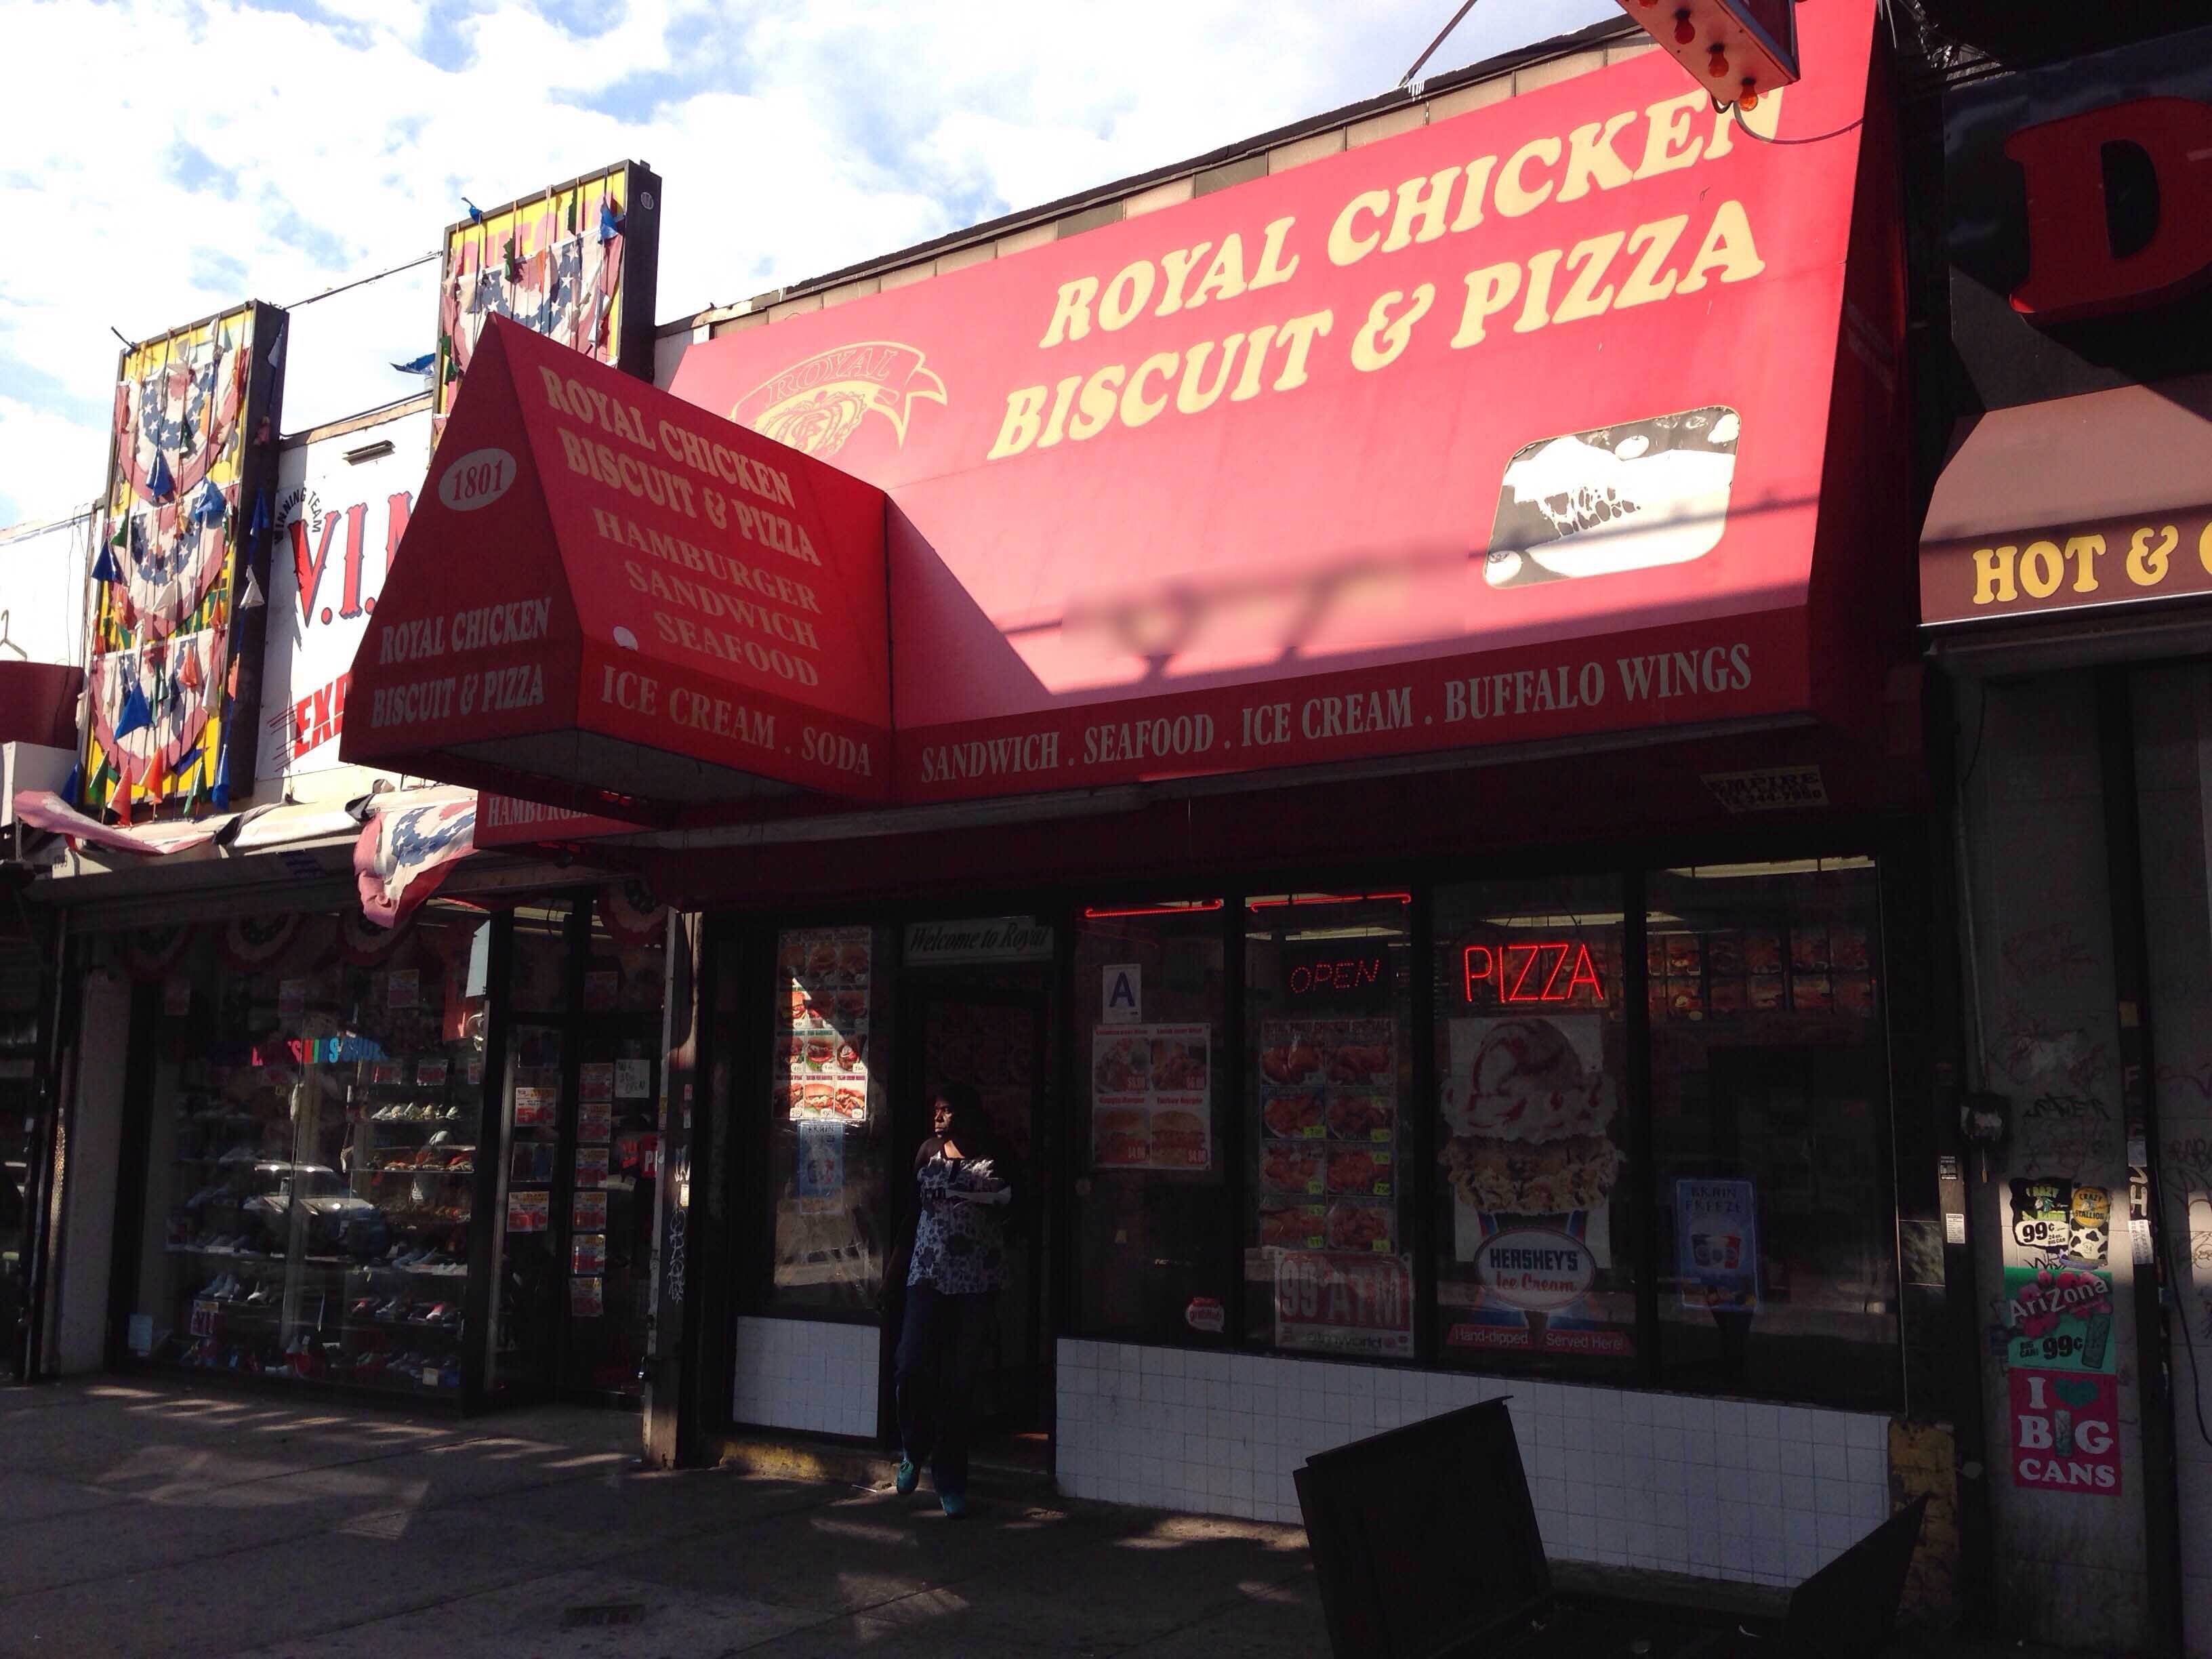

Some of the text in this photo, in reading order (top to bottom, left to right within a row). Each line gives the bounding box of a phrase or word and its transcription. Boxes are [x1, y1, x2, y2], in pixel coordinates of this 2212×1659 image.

[1039, 83, 1786, 348] ROYAL CHICKEN
[987, 199, 1766, 460] BISCUIT & PIZZA
[765, 348, 897, 407] ROYAL
[539, 365, 796, 510] ROYAL CHICKEN
[453, 460, 504, 502] 1801
[556, 426, 821, 567] BISCUIT & PIZZA
[274, 487, 322, 545] WINNING TEAM
[592, 507, 822, 615] HAMBURGER
[1972, 534, 2107, 605] HOT
[2126, 524, 2179, 587] &
[380, 596, 552, 666] ROYAL CHICKEN
[624, 559, 821, 652] SANDWICH
[653, 611, 819, 688] SEAFOOD
[371, 664, 546, 729] BISCUIT & PIZZA
[601, 664, 657, 717] ICE
[669, 687, 775, 751] CREAM
[802, 728, 872, 777] SODA
[922, 731, 1060, 783] SANDWICH
[1084, 714, 1214, 764] SEAFOOD
[1241, 703, 1291, 747] ICE
[1301, 687, 1413, 740] CREAM
[1443, 661, 1605, 723] BUFFALO
[1616, 642, 1753, 702] WINGS
[910, 926, 980, 952] Welcome
[981, 928, 999, 949] to
[1109, 972, 1135, 1007] A
[1290, 958, 1382, 994] OPEN
[1463, 942, 1605, 1004] PIZZA
[1490, 1248, 1579, 1271] HERSHEY'S
[1495, 1271, 1574, 1293] Ice Cream
[2009, 1278, 2110, 1327] AriZona
[1454, 1328, 1529, 1347] Hand-dipped
[1545, 1332, 1589, 1349] Served
[2043, 1334, 2084, 1360] 99¢
[2027, 1376, 2048, 1410] I
[2018, 1458, 2116, 1489] CANS
